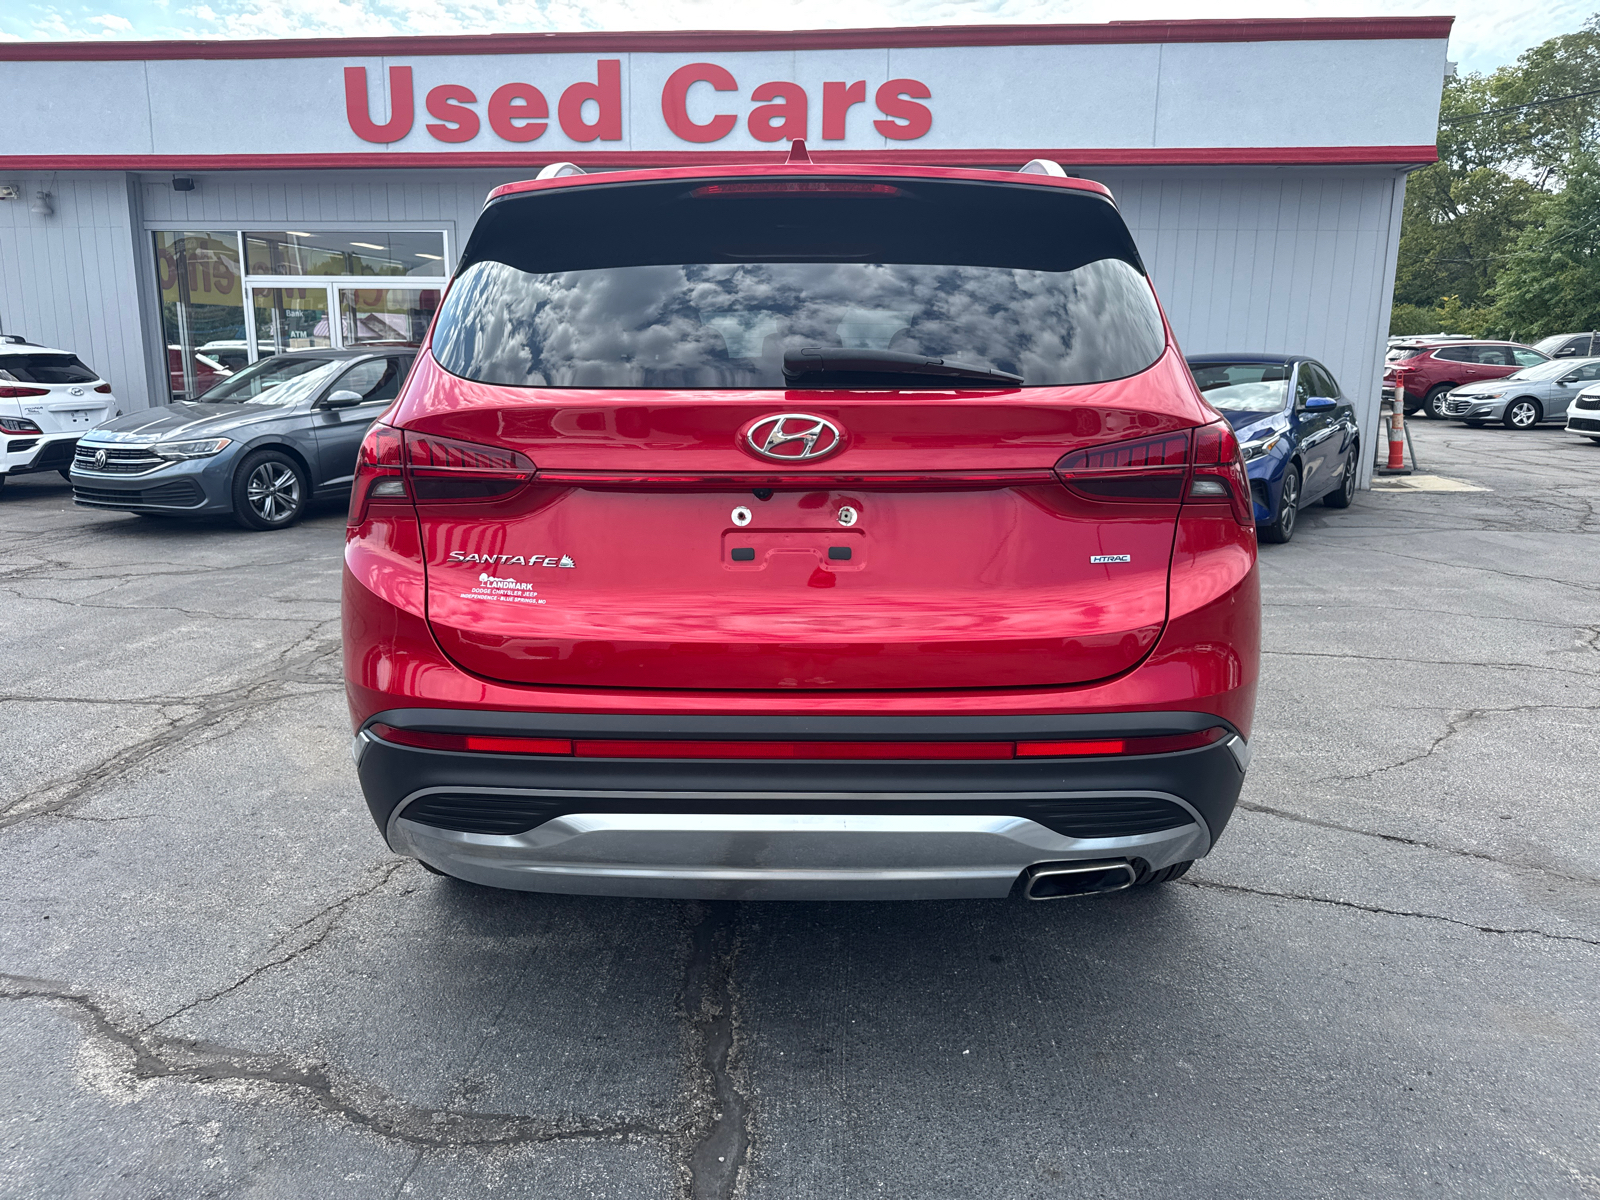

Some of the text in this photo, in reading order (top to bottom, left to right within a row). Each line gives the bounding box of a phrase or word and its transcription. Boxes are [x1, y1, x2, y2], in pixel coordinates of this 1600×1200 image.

[344, 59, 933, 143] Used Cars
[487, 581, 533, 590] LANDMARK
[460, 593, 497, 601] INDEPENDENCE
